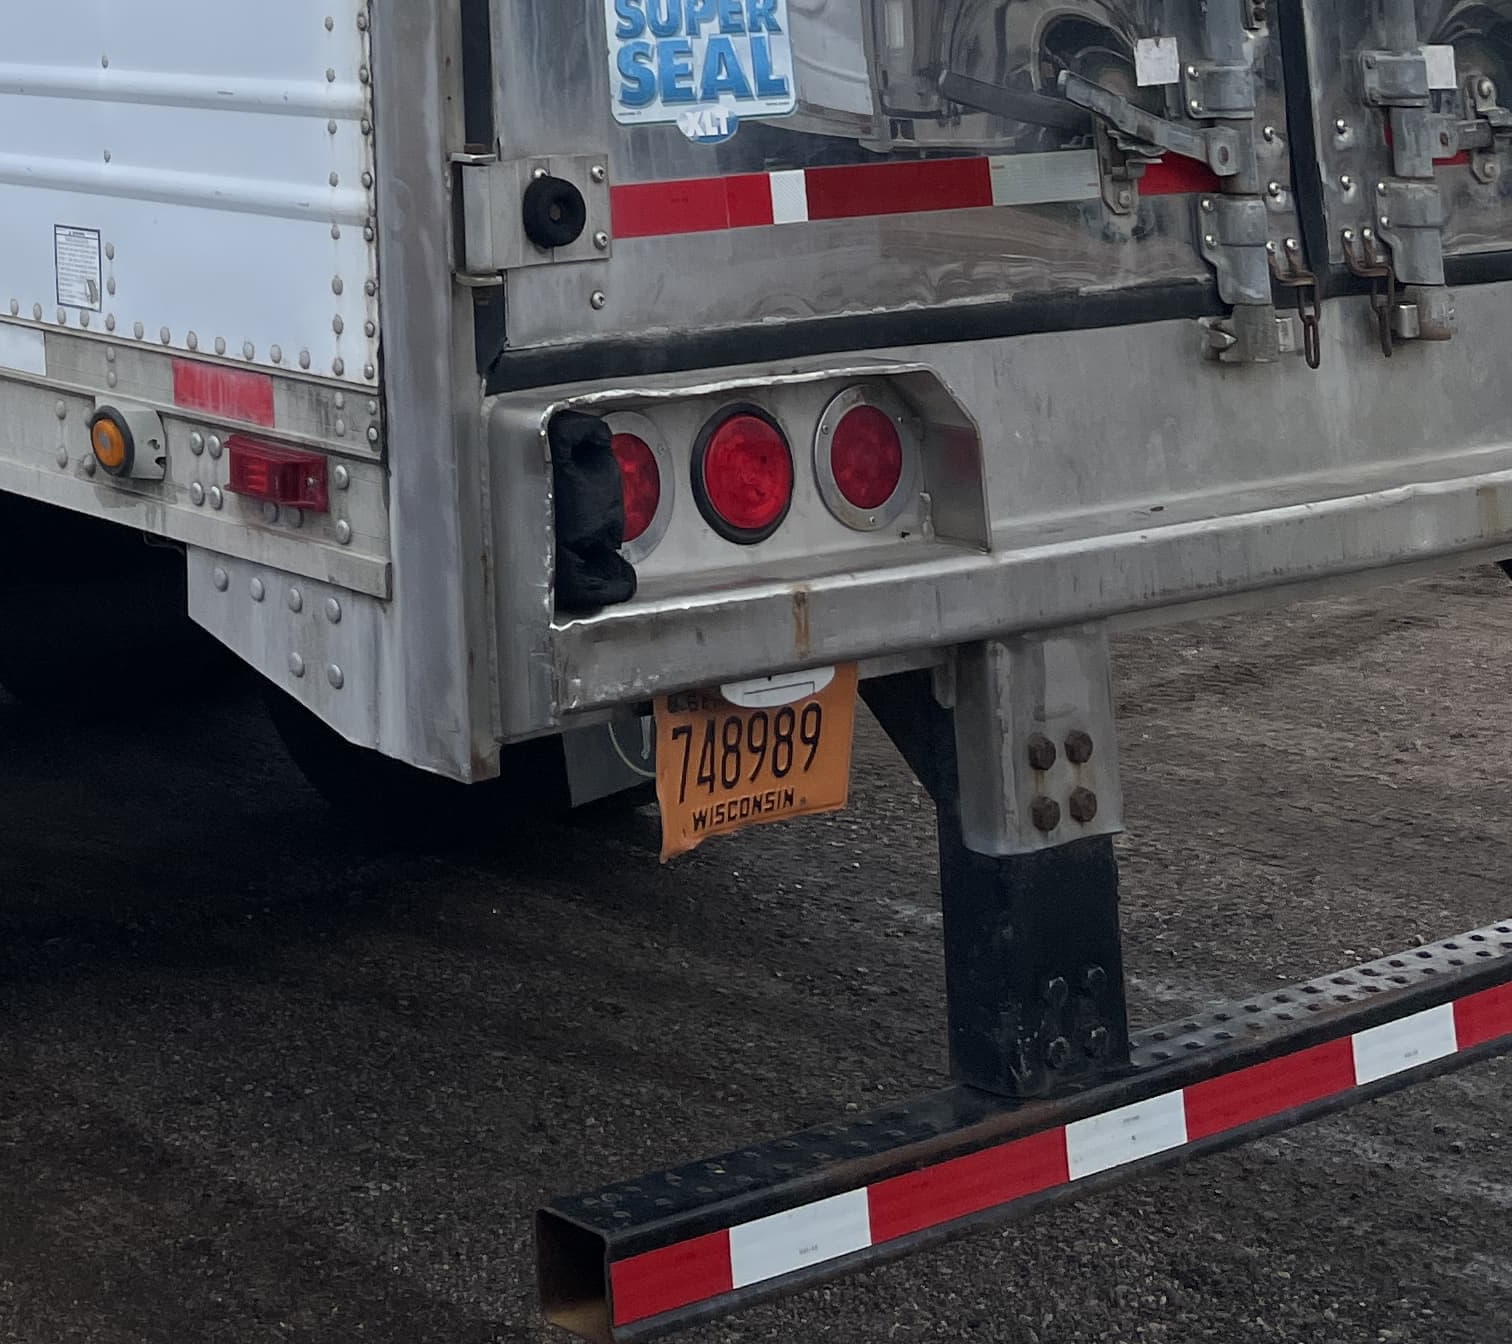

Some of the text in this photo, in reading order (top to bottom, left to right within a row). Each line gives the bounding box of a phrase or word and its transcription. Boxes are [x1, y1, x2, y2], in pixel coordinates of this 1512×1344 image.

[616, 33, 791, 108] SEAL
[684, 107, 731, 137] XLT
[671, 700, 823, 805] 748989
[691, 787, 796, 832] WISCONSIN
